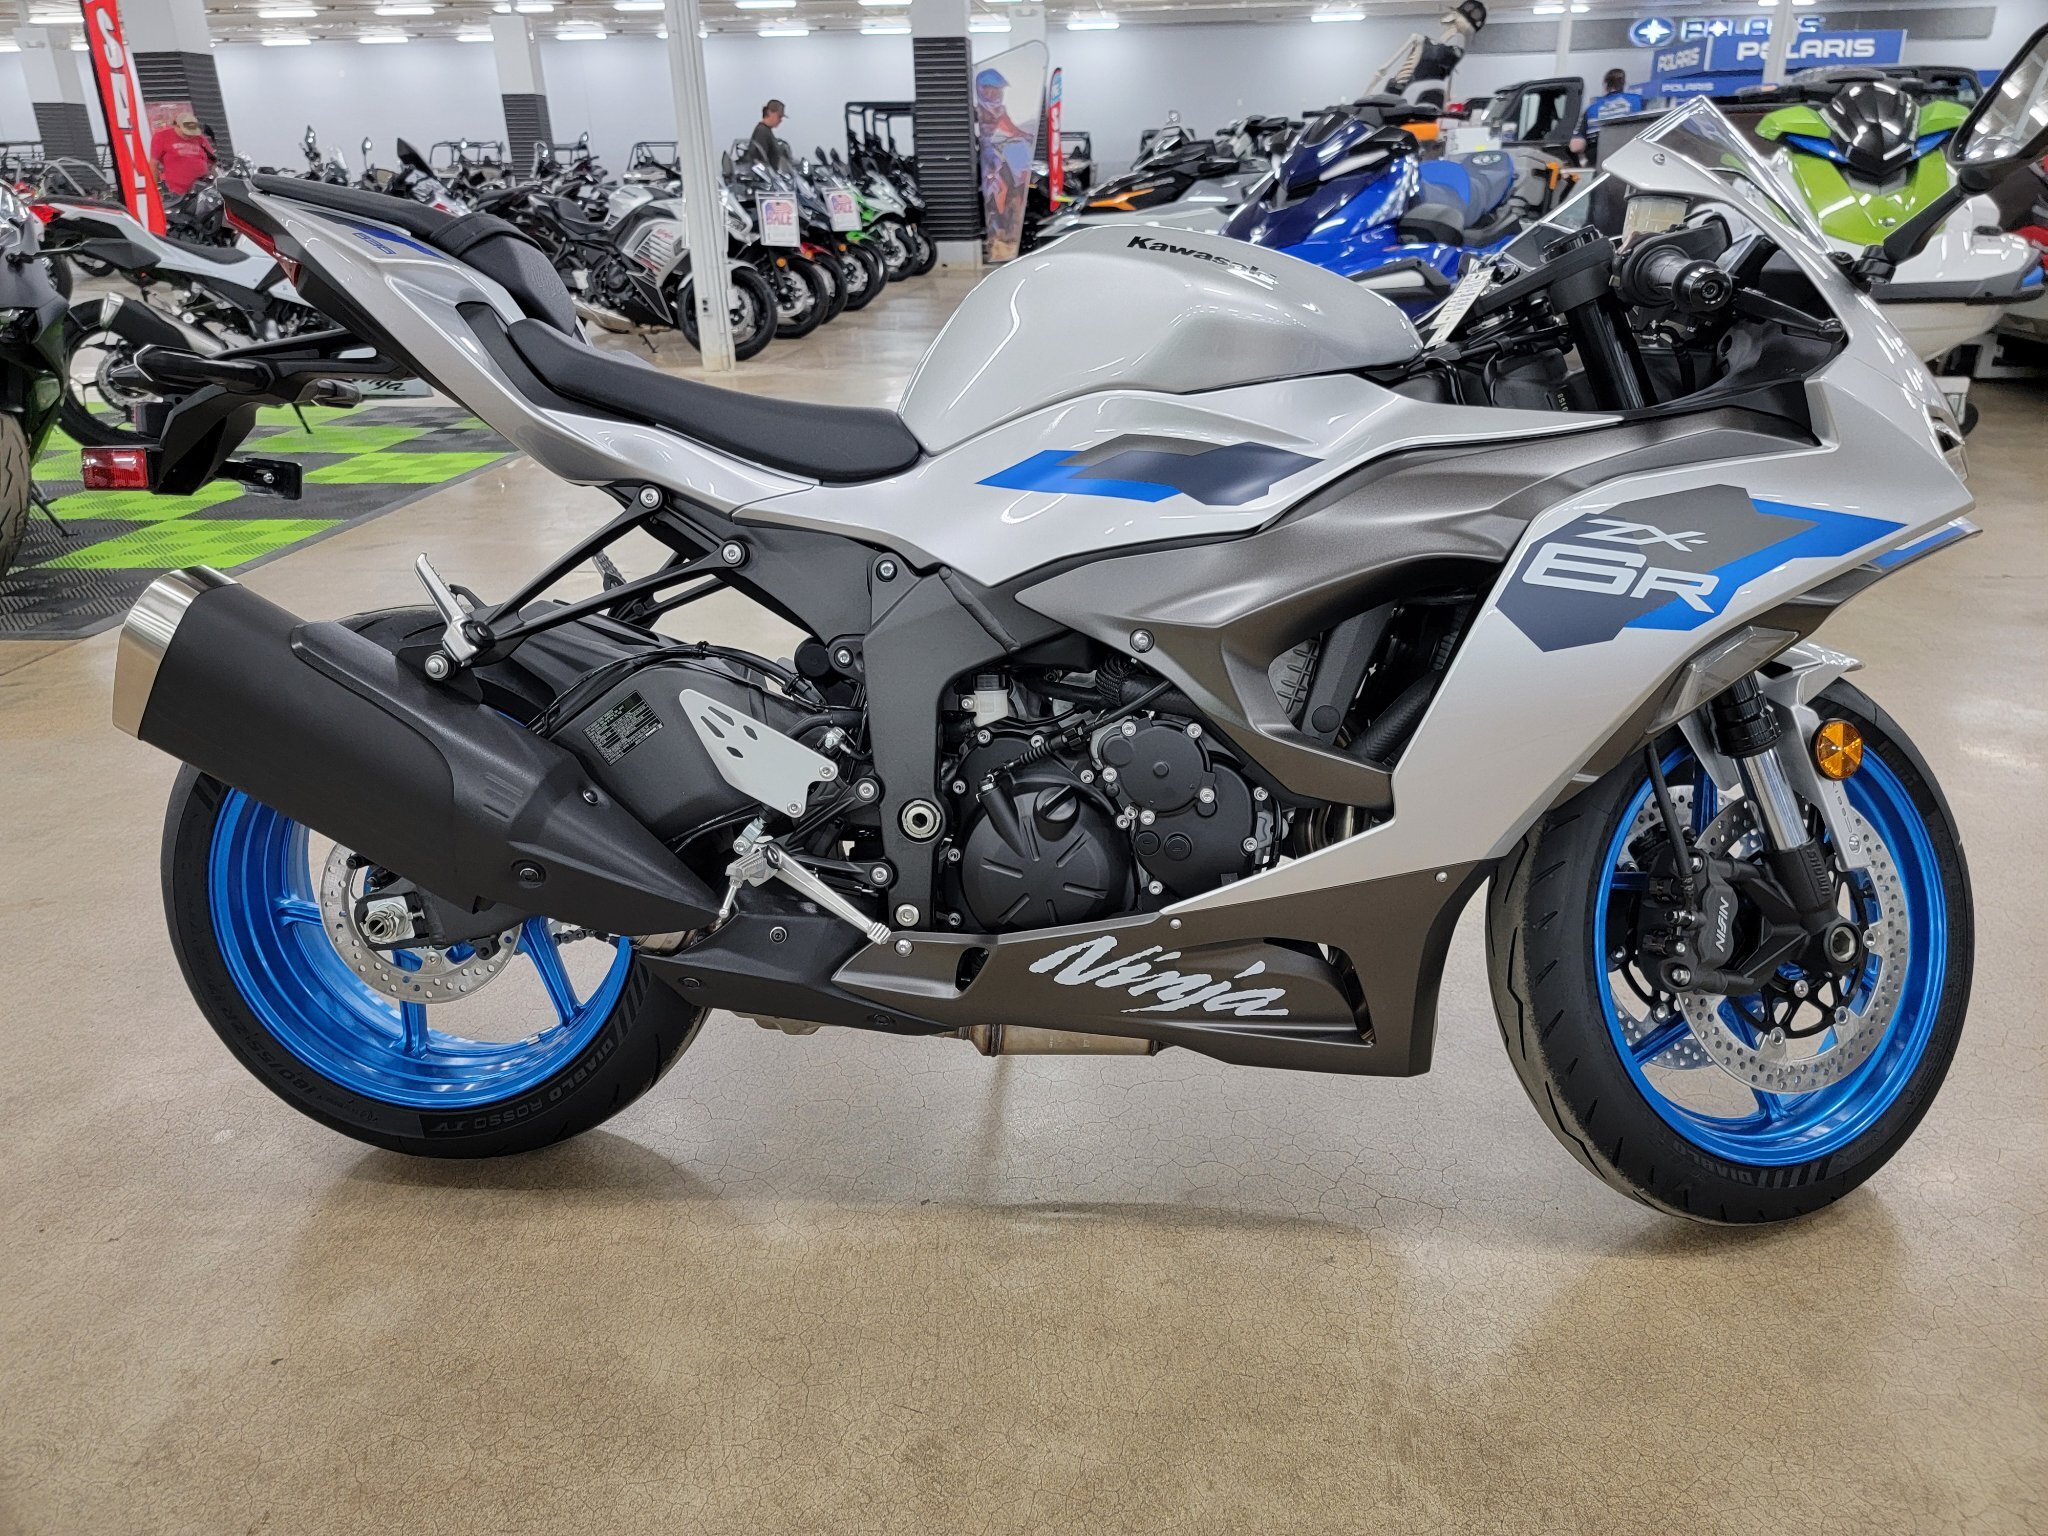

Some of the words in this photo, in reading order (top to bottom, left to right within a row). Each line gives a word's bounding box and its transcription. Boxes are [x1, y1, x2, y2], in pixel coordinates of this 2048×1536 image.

[1127, 236, 1278, 285] Kawasaki
[1522, 542, 1720, 614] 6R
[1806, 850, 1831, 897] SHOWA
[1714, 896, 1730, 953] NISSIN
[1028, 935, 1290, 1017] Ninja
[549, 1040, 617, 1101] DIABLO
[474, 1099, 543, 1130] ROSSO
